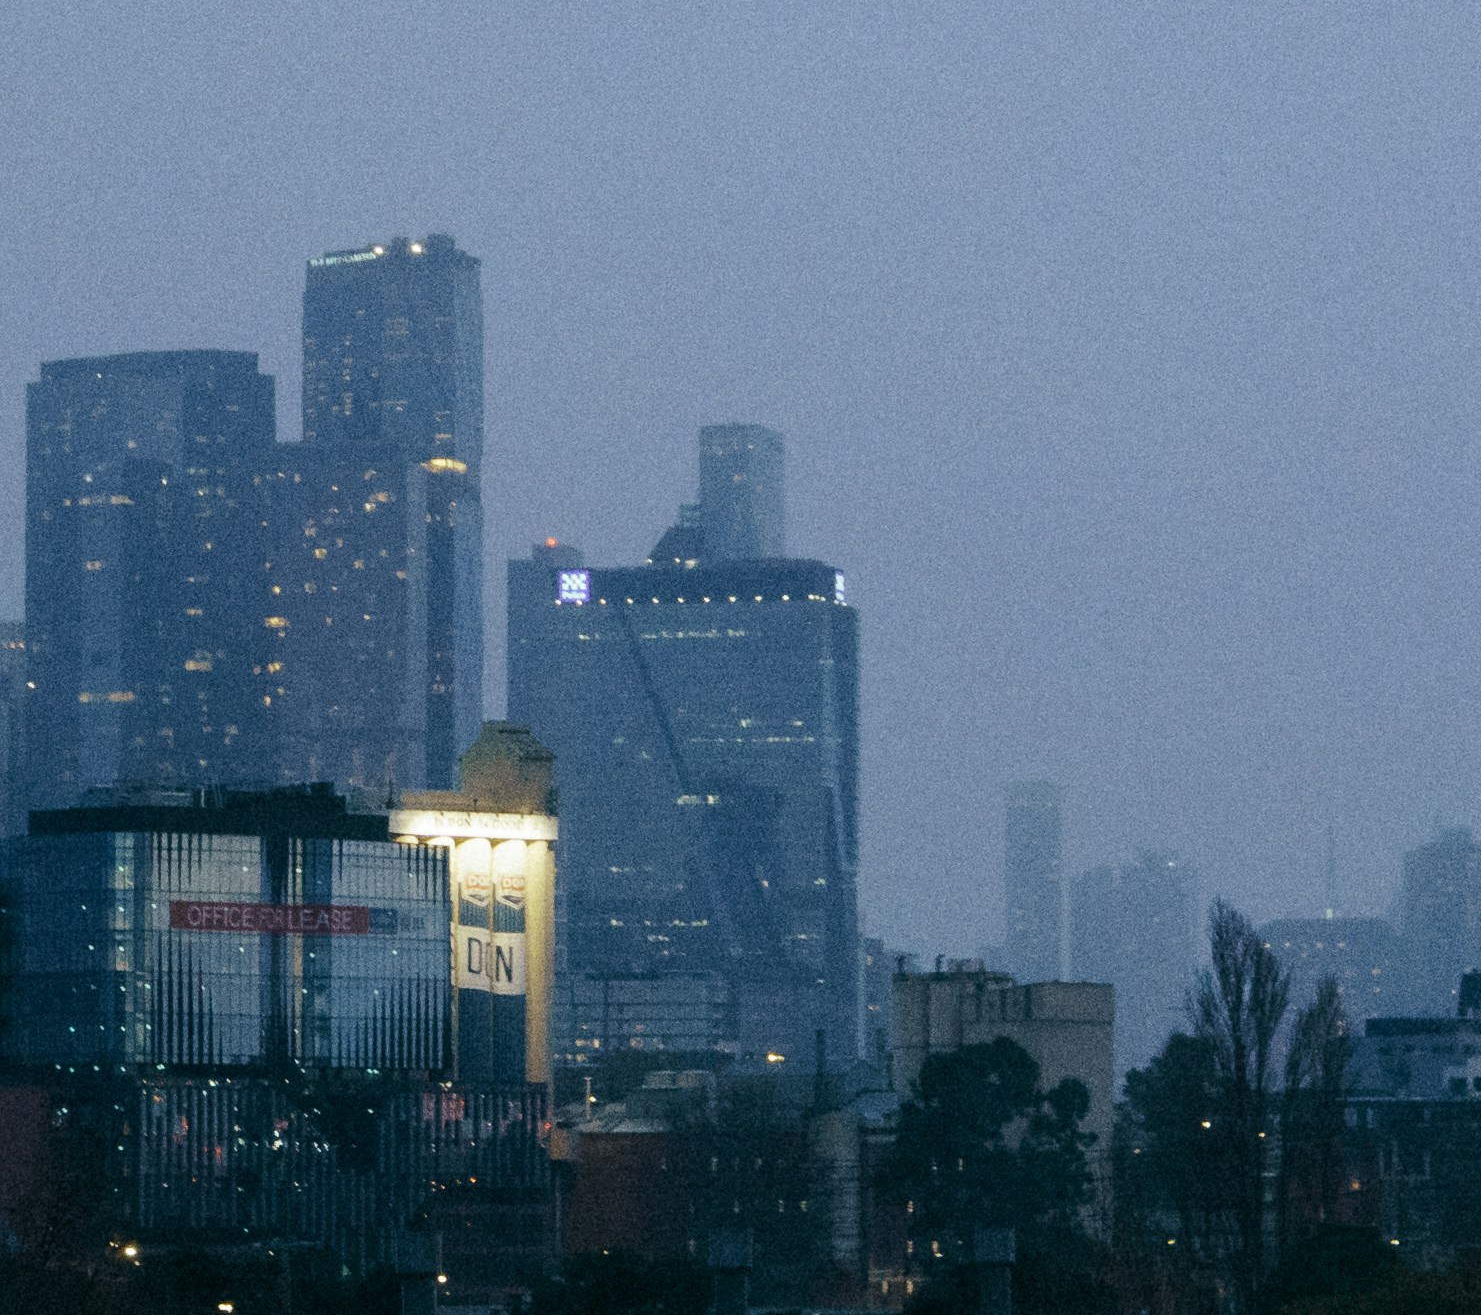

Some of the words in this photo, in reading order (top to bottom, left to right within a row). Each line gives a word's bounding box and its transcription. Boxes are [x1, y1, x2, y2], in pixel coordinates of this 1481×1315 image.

[467, 874, 489, 887] DO
[186, 905, 253, 929] OFFICE
[257, 908, 284, 930] FOR
[288, 907, 353, 932] LEASE
